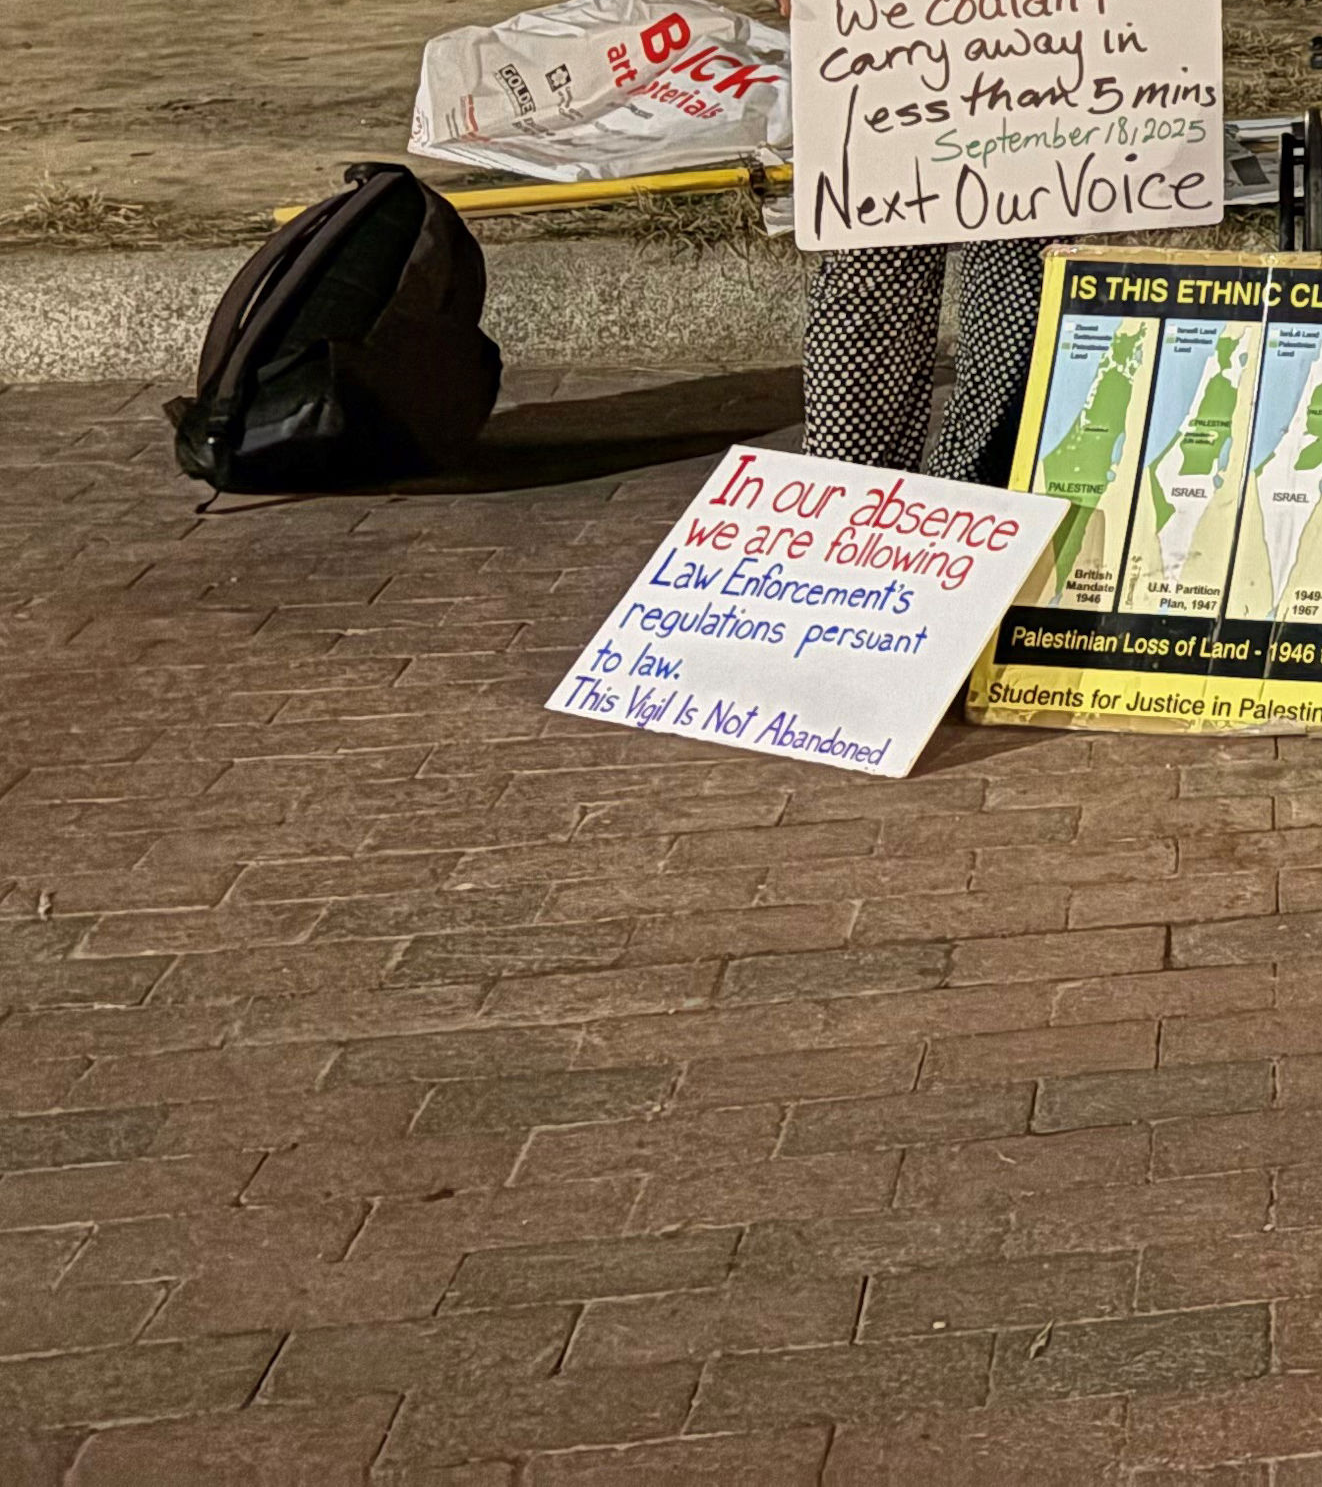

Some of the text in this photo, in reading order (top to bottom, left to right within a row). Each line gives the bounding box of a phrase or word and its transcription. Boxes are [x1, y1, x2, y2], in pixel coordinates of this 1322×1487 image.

[607, 43, 638, 88] art
[819, 22, 1148, 93] carry away in
[960, 72, 1081, 115] than
[1087, 77, 1123, 114] 5
[1131, 66, 1217, 109] mins
[931, 117, 1099, 167] September
[1143, 119, 1206, 144] 2025
[815, 153, 1213, 241] Next Our Voice
[1070, 275, 1097, 300] IS
[1106, 277, 1168, 303] THIS
[1177, 279, 1281, 307] ETHNIC
[709, 455, 1020, 551] In our absence
[1047, 482, 1105, 494] PALESTINE
[1171, 487, 1208, 499] ISRAEL
[1272, 492, 1309, 504] ISRAEL
[684, 517, 975, 590] we are following
[649, 548, 915, 614] Law Enforcement's
[1066, 581, 1115, 593] Mandate
[1075, 569, 1113, 582] British
[1148, 583, 1221, 597] U.N. Partition
[1076, 593, 1101, 605] 1946
[1160, 598, 1217, 612] Plan, 1947
[1292, 605, 1319, 617] 1967
[618, 602, 927, 659] regulations persuant
[1011, 625, 1117, 652] Palestinian
[1122, 631, 1170, 655] Loss
[1175, 632, 1197, 656] of
[1200, 635, 1248, 660] Land
[1269, 640, 1314, 663] 1946
[590, 643, 680, 680] to law.
[988, 682, 1084, 707] Students
[1090, 687, 1120, 710] for
[1126, 692, 1206, 715] Justice
[1210, 695, 1231, 716] in
[564, 676, 891, 766] This Vigil Is Not Abandoned
